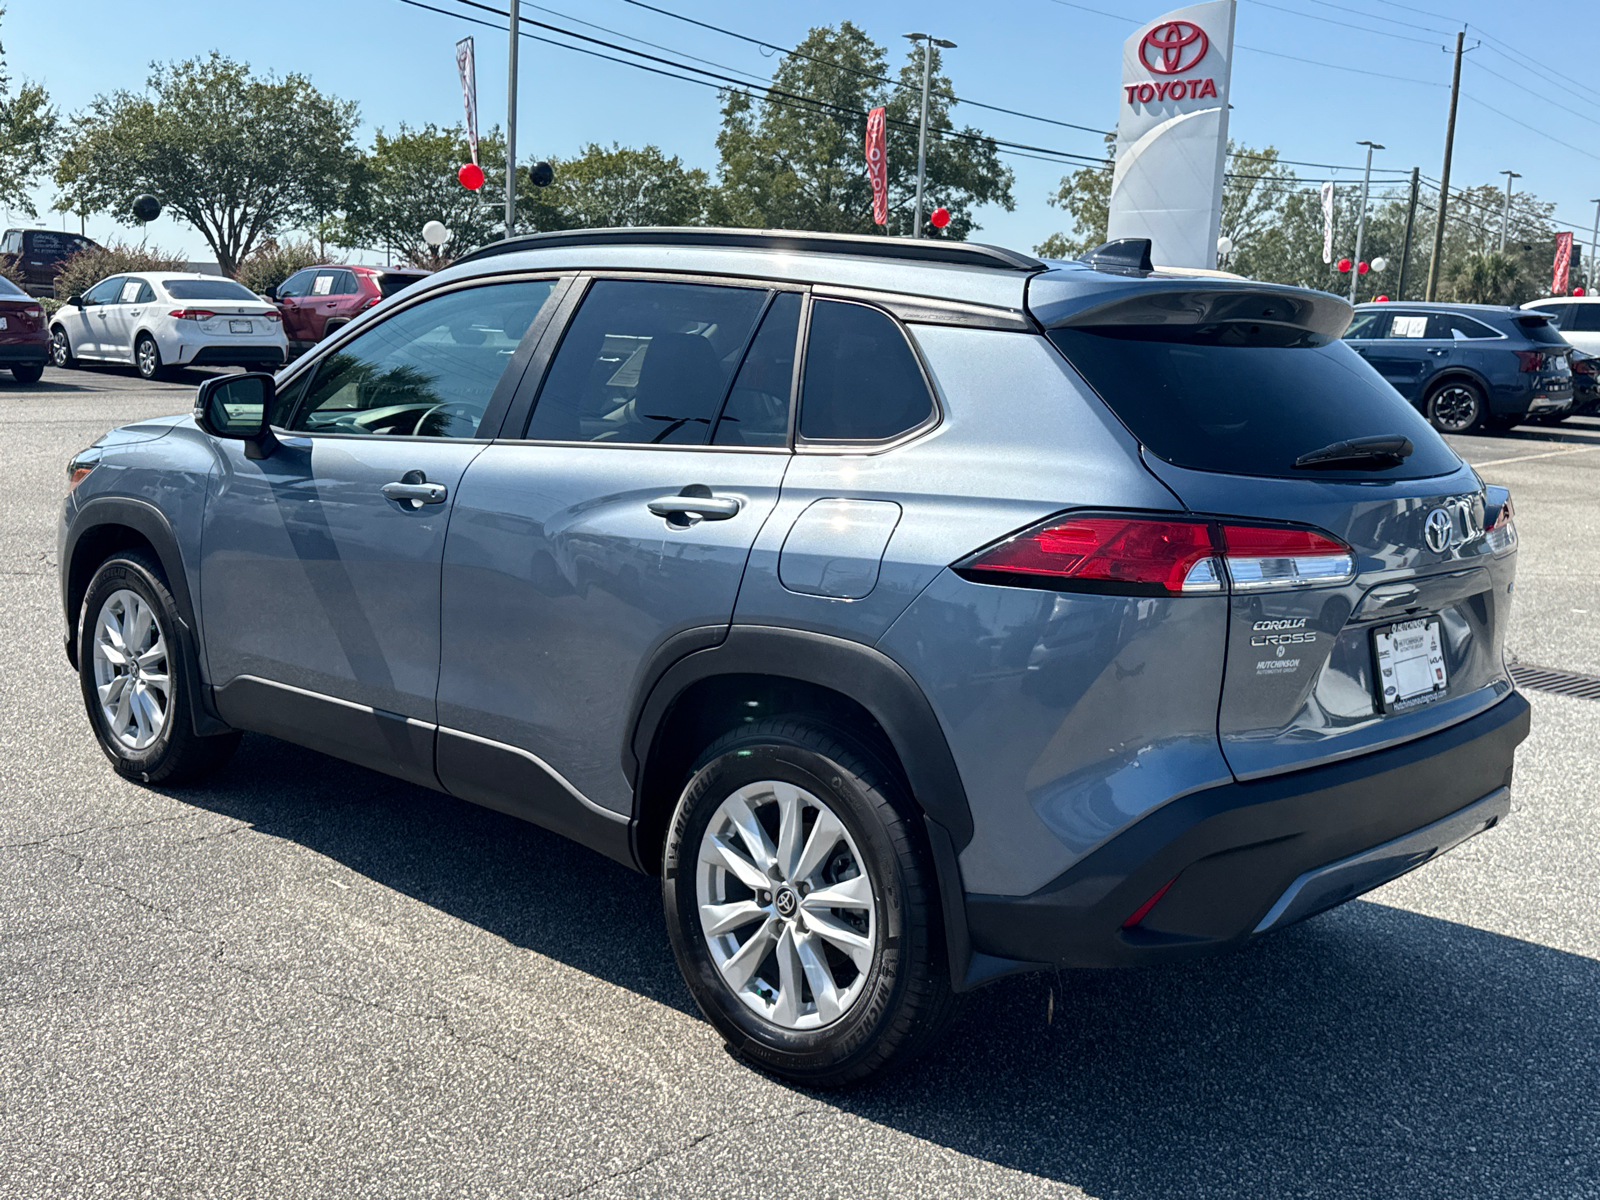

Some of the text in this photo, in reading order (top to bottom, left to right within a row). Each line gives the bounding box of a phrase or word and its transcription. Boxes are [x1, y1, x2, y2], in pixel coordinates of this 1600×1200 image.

[1124, 78, 1217, 104] TOYOTA
[868, 133, 882, 218] TOYOTA
[1253, 618, 1306, 631] COROLLA
[1250, 631, 1316, 646] CROSS
[1256, 659, 1300, 670] HUTCHINSON
